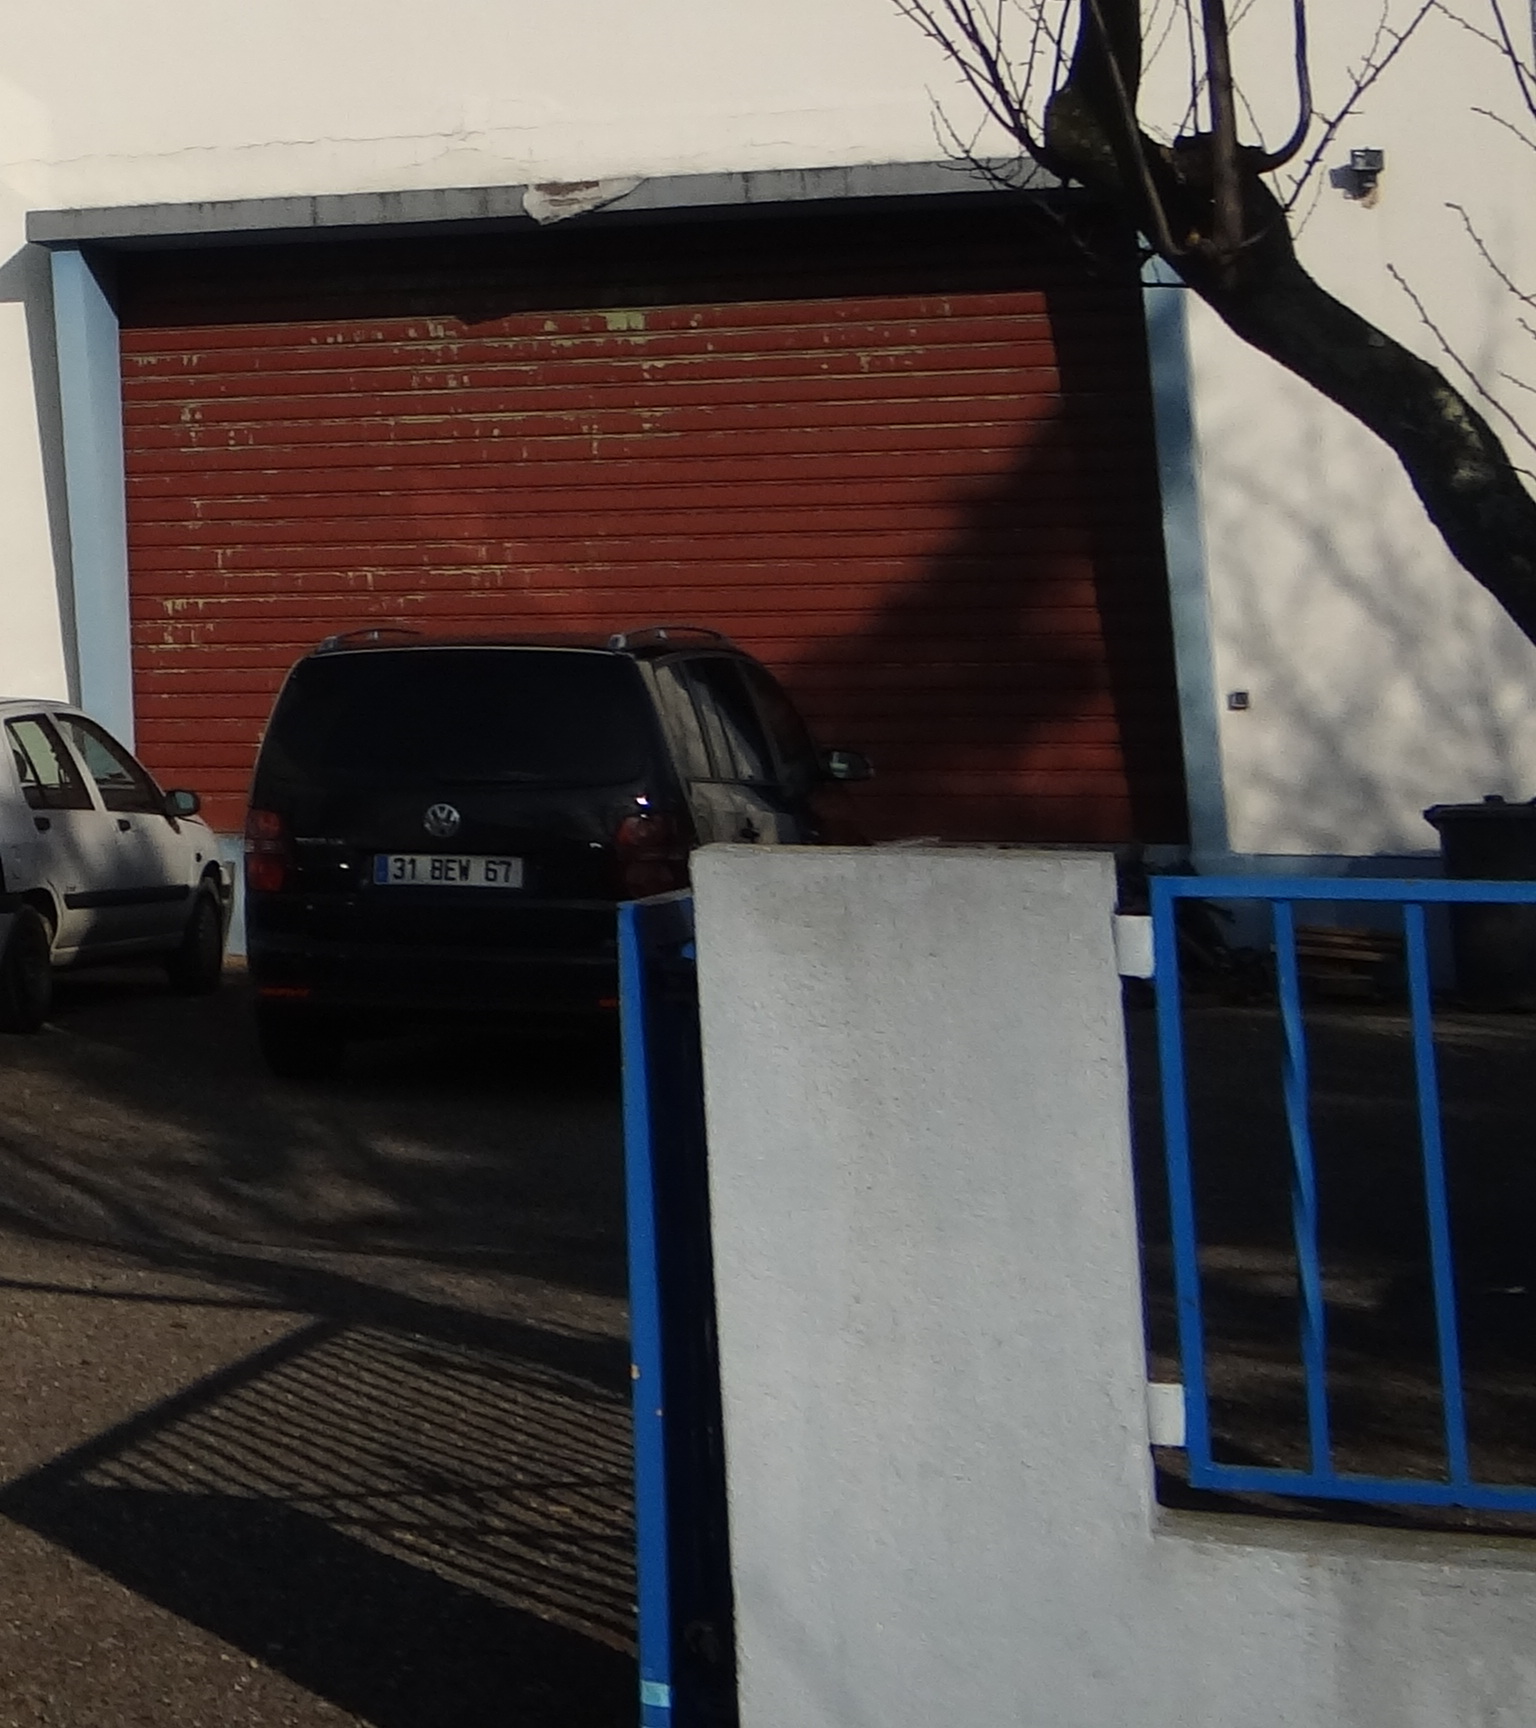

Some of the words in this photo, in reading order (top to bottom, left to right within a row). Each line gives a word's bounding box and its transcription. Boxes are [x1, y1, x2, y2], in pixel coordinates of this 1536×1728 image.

[393, 858, 417, 881] 31
[430, 859, 471, 882] BEW
[485, 860, 513, 883] 67
